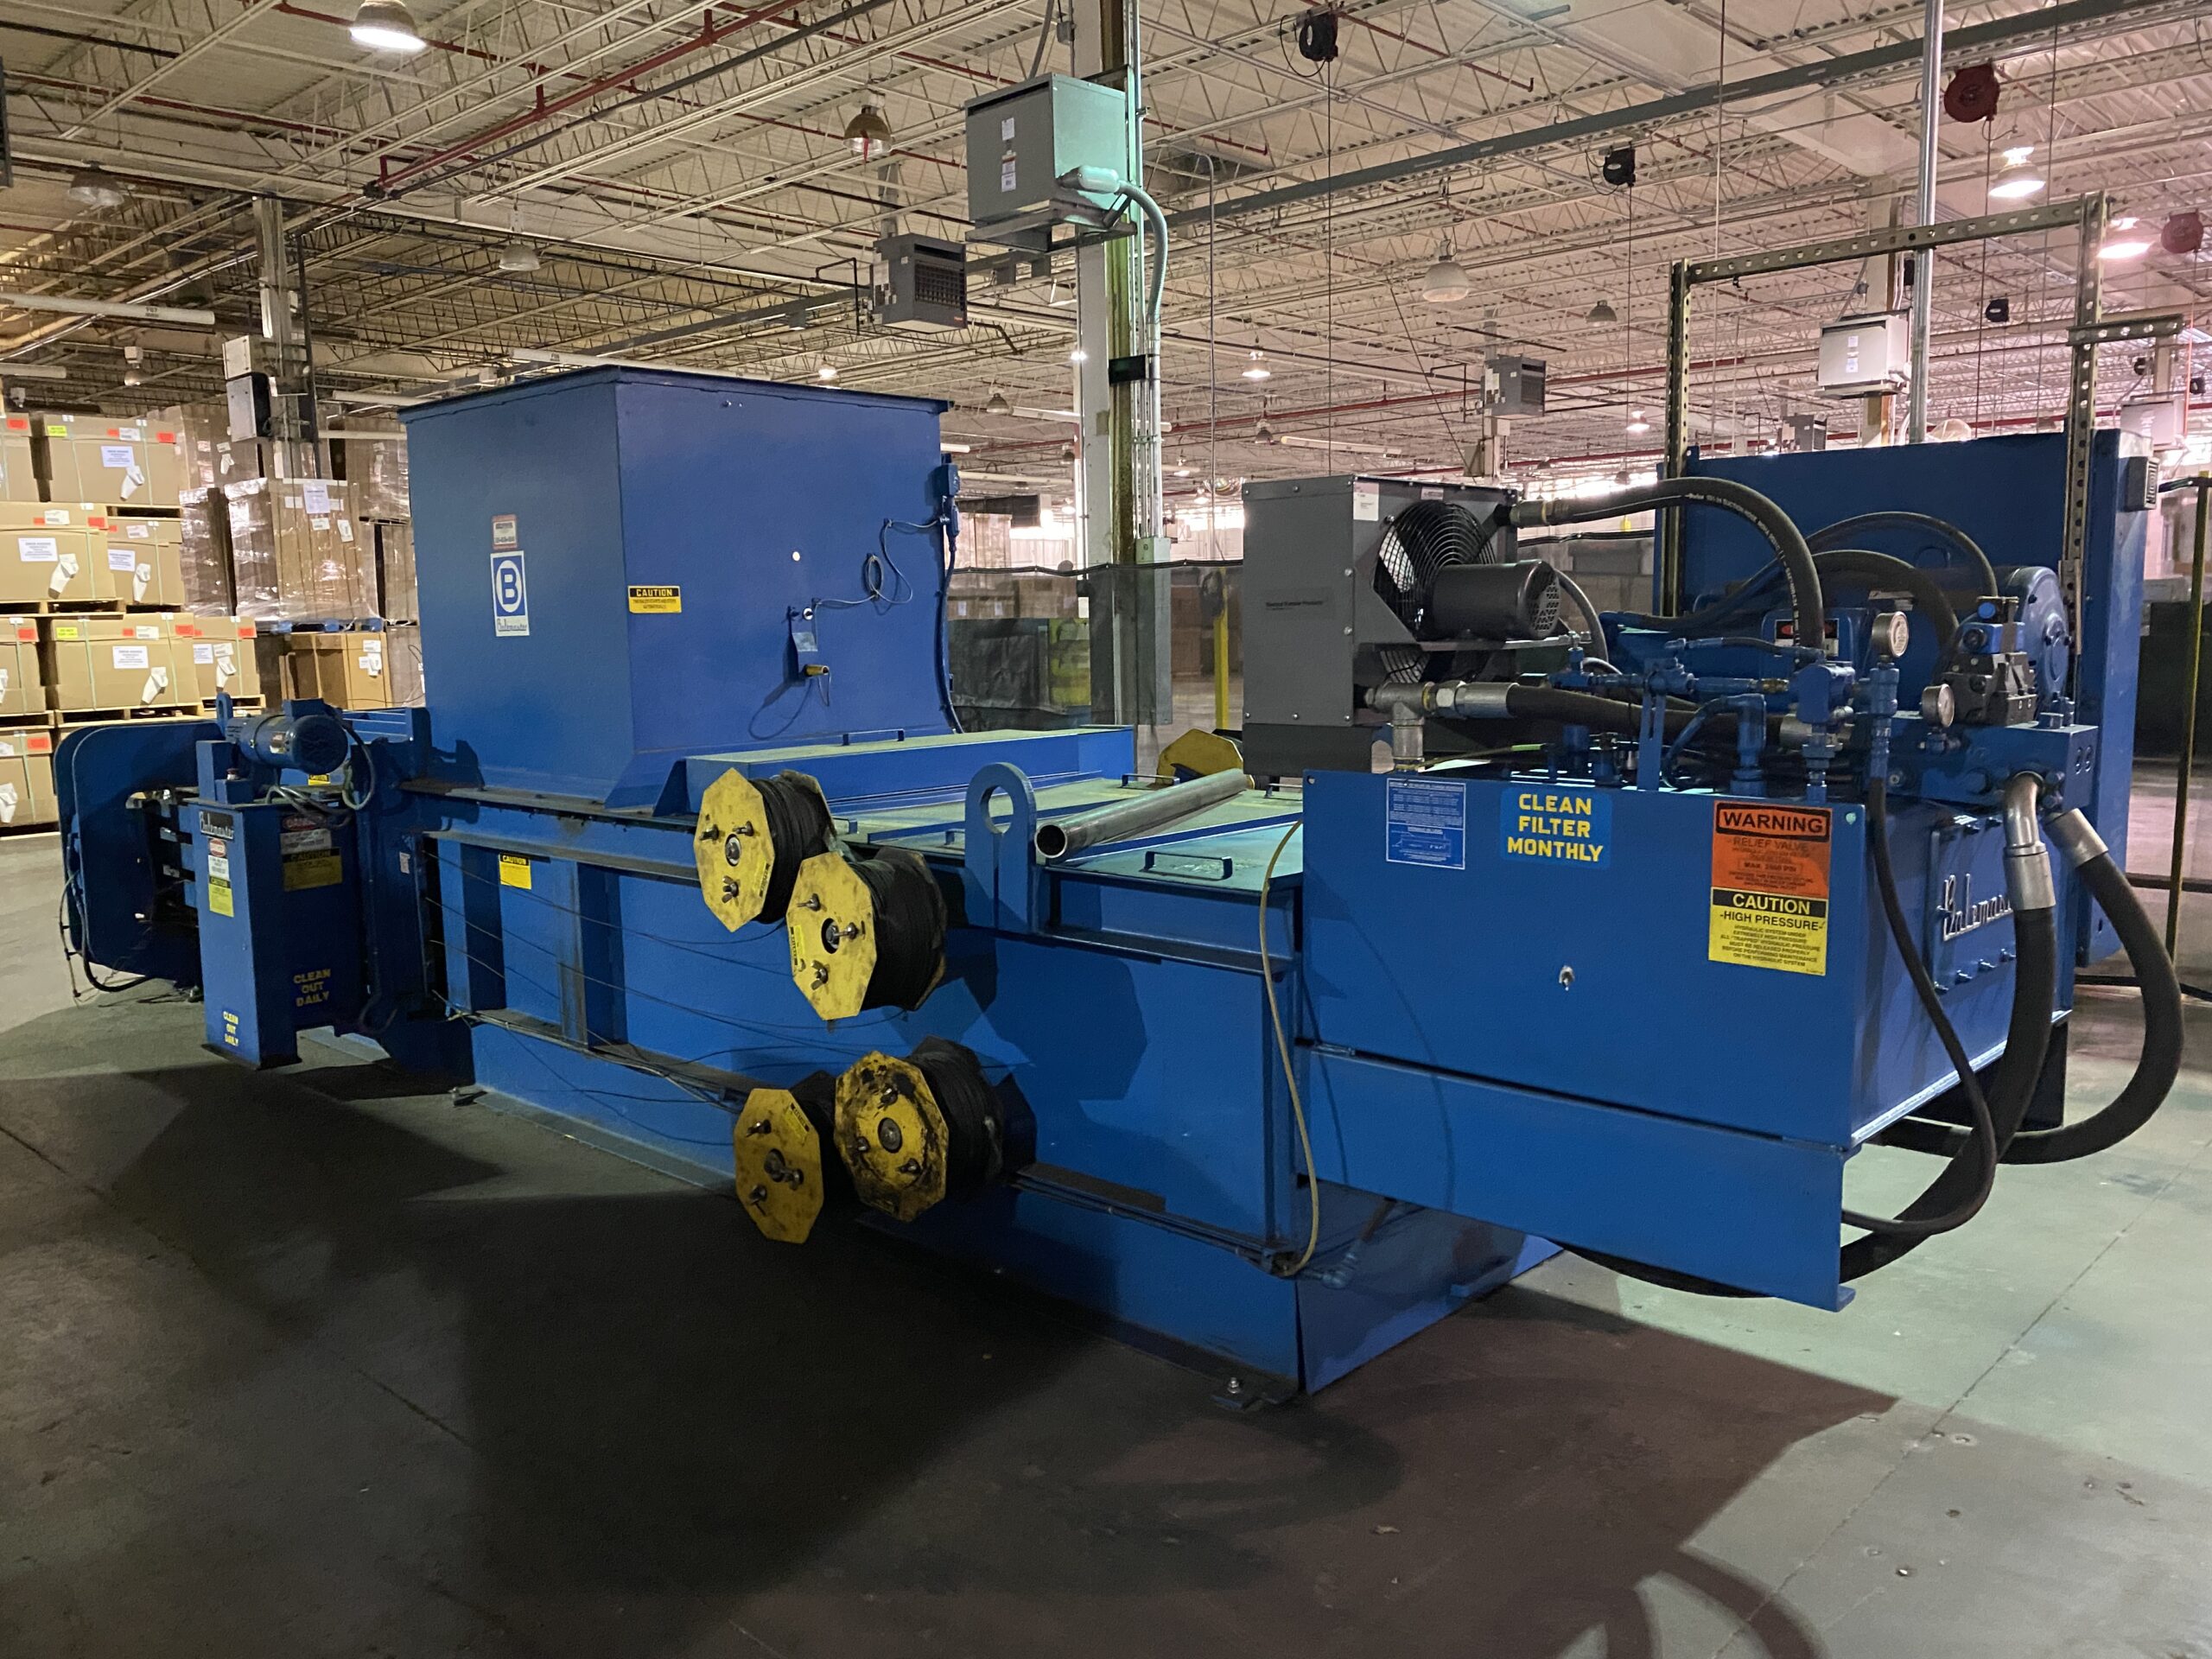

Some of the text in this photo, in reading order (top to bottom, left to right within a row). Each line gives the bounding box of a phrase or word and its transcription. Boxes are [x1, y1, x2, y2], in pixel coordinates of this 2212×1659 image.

[500, 568, 518, 605] B
[636, 588, 672, 597] CAUTION
[1519, 793, 1592, 815] CLEAN
[1519, 816, 1591, 838] FILTER
[1723, 811, 1822, 833] WARNING
[1507, 836, 1604, 862] MONTHLY
[1732, 836, 1809, 853] RELIEF VALVE
[1732, 893, 1811, 915] CAUTION
[294, 968, 331, 983] CLEAN
[302, 981, 324, 994] OUT
[296, 991, 329, 1007] DAILY
